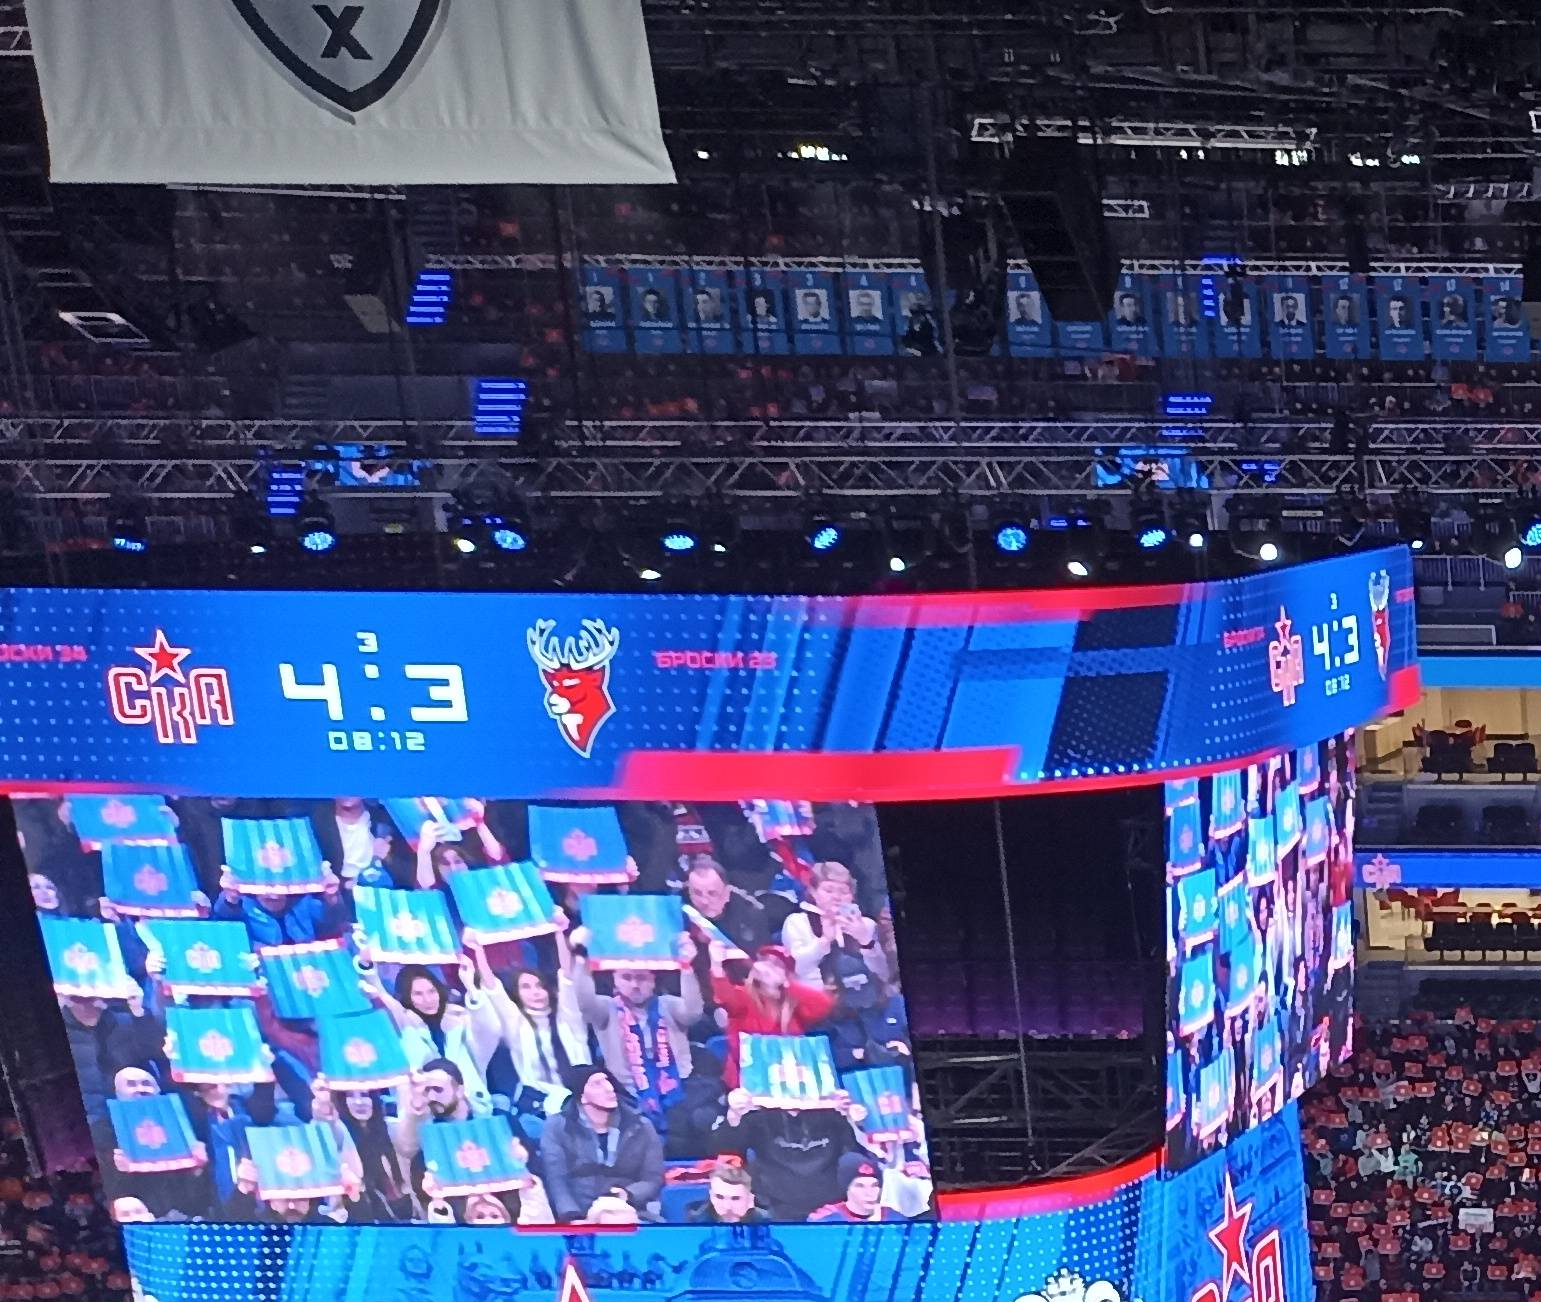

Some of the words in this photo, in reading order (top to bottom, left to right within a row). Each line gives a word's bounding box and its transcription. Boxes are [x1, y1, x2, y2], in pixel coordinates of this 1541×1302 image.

[356, 632, 378, 653] 3
[107, 667, 235, 744] СКА
[328, 730, 426, 752] 08:12
